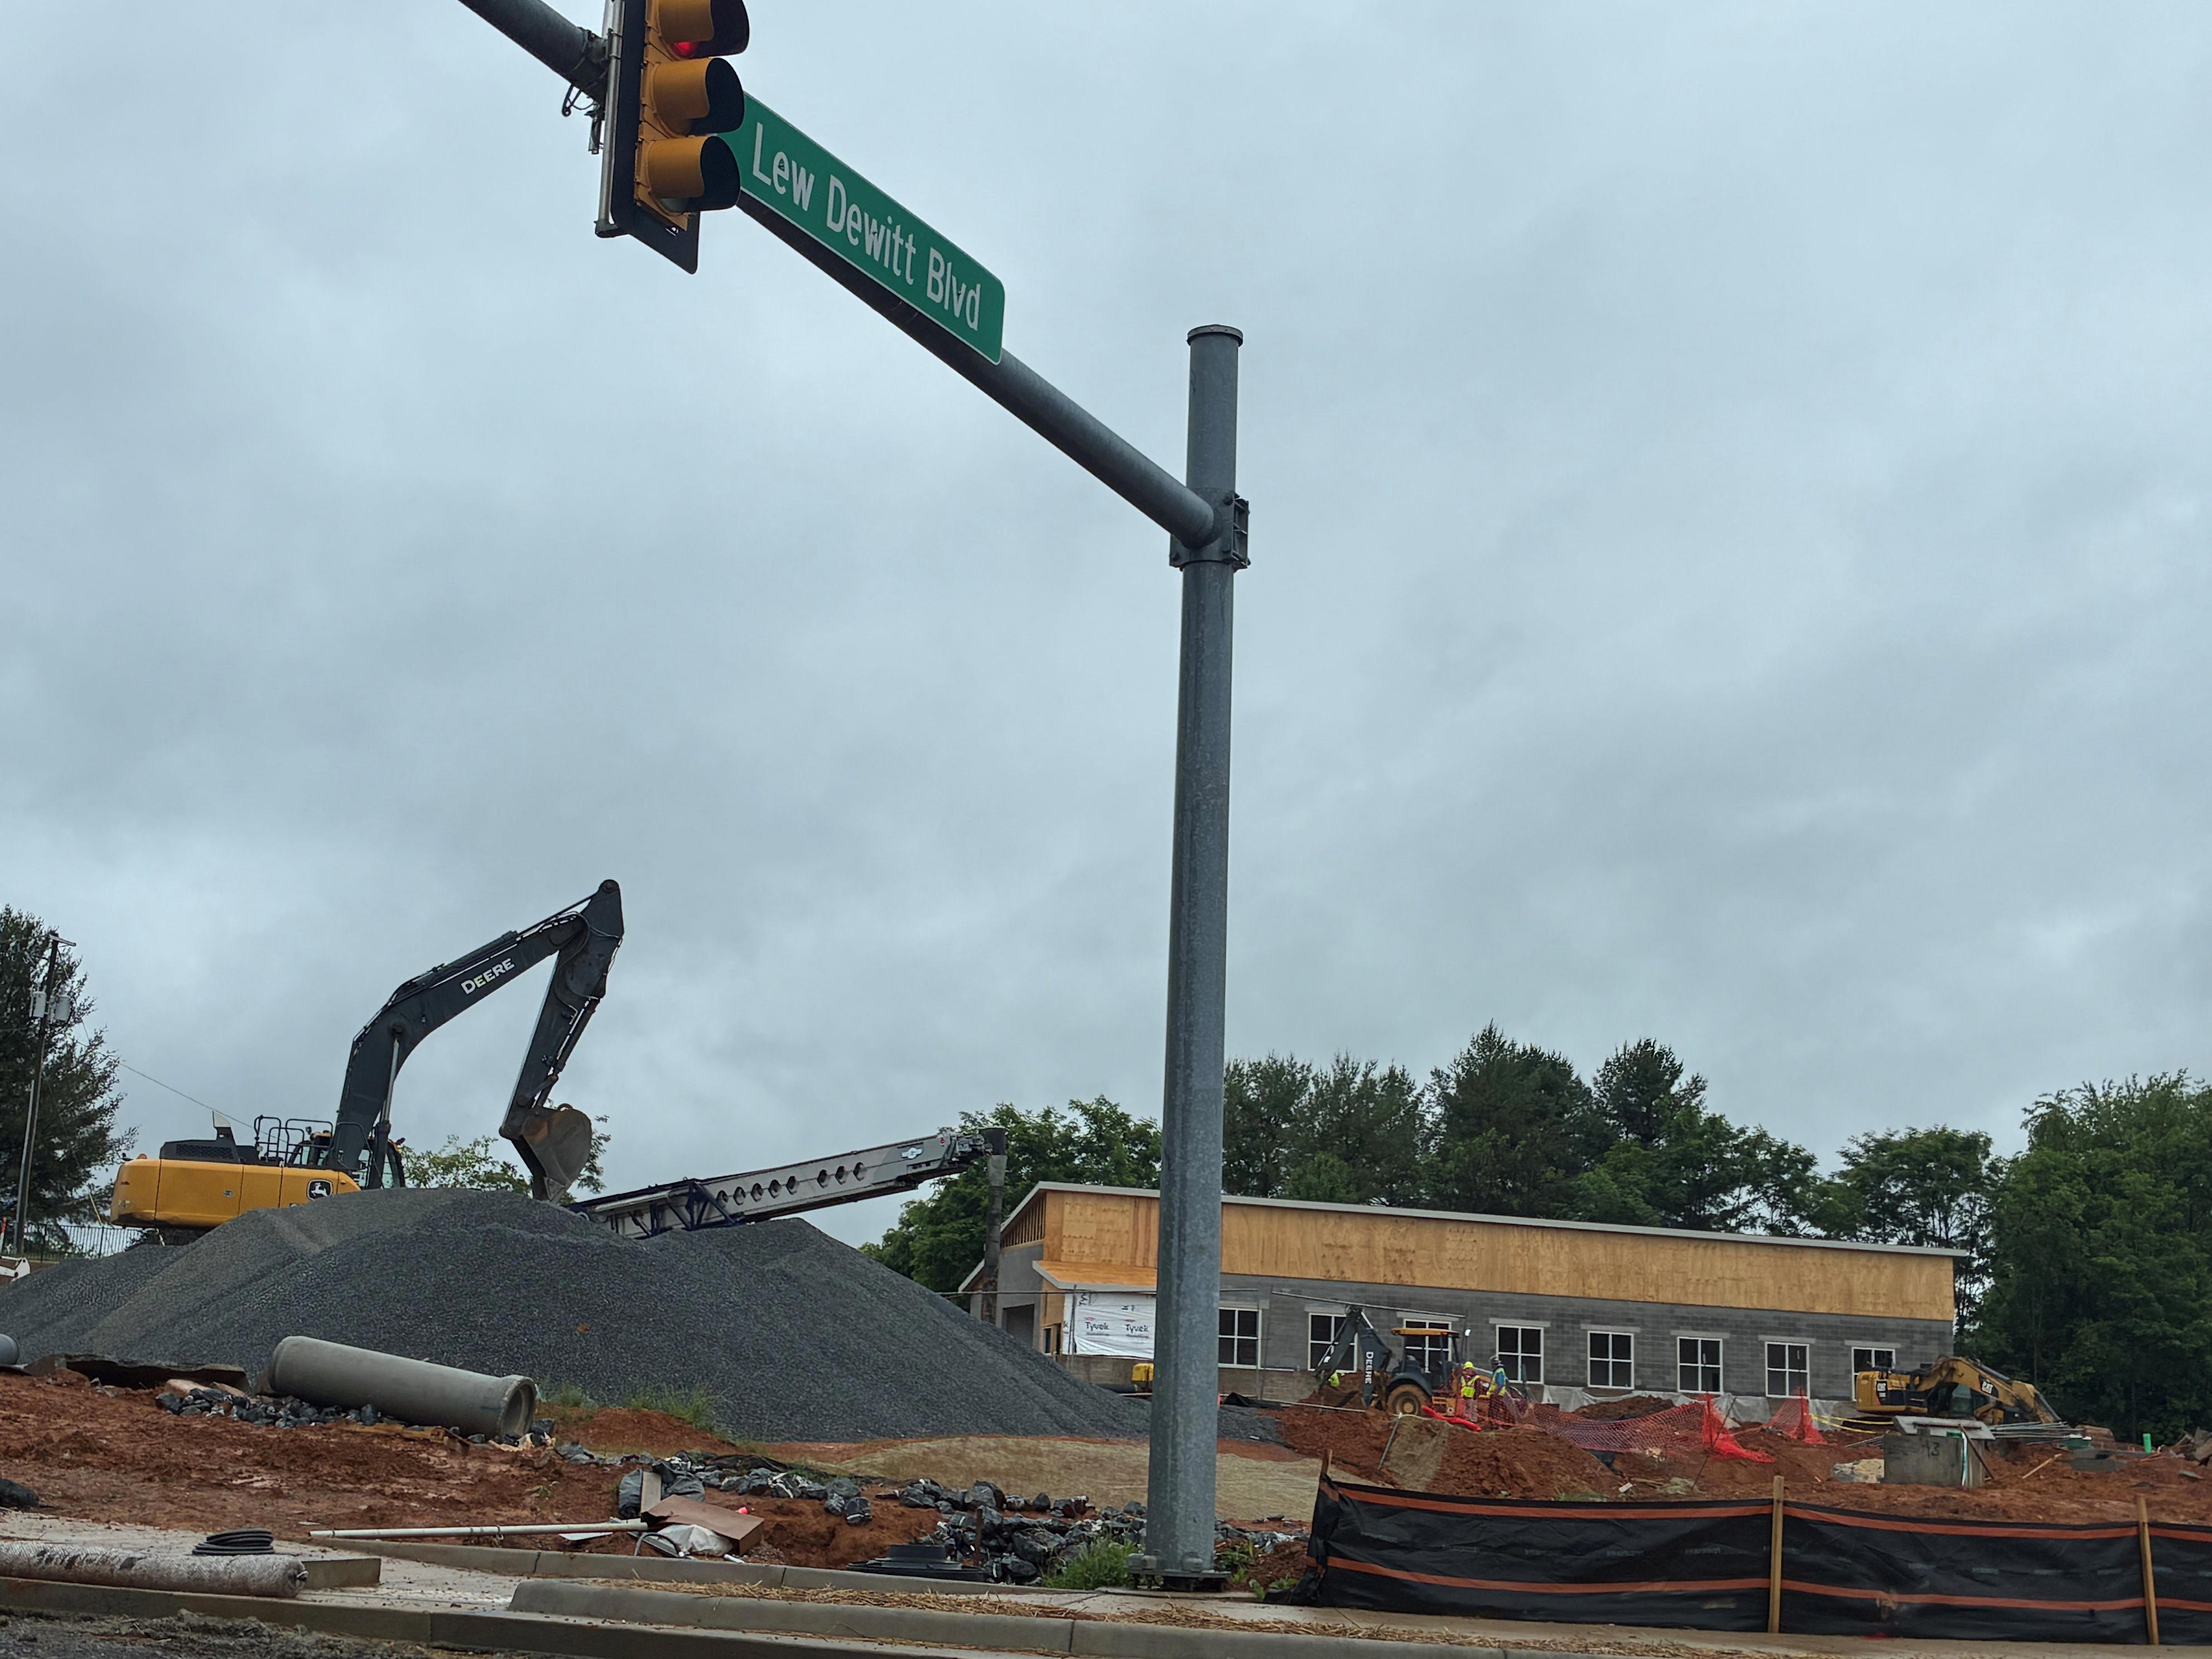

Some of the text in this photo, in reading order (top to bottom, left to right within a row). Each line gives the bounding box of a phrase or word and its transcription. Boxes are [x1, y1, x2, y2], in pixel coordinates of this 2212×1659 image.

[752, 122, 981, 331] Lew Dewitt Blvd
[461, 958, 515, 995] DEERE
[1085, 1322, 1110, 1332] Tyvek
[1125, 1324, 1149, 1334] Tyvek
[1365, 1351, 1374, 1384] DEERE
[1982, 1381, 1994, 1395] CAT
